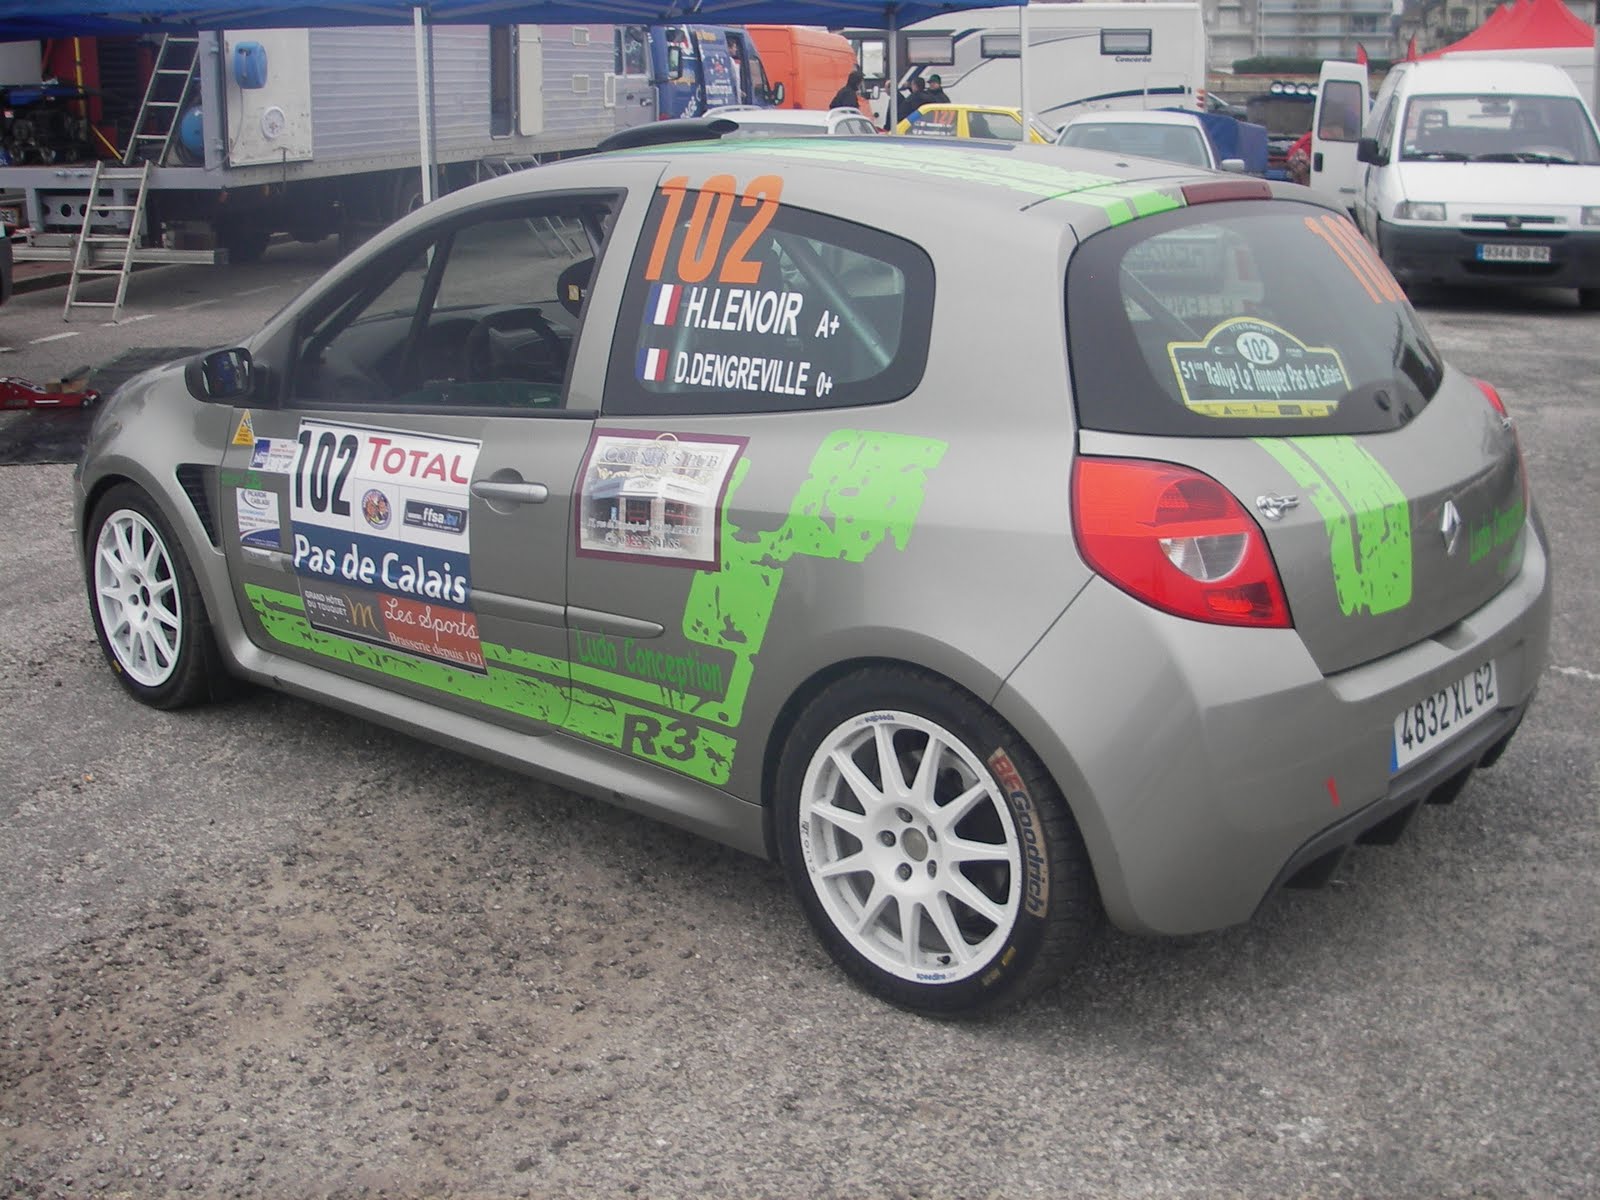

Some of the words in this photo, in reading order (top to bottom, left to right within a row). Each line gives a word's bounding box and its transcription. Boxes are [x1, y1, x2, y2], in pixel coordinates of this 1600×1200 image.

[643, 174, 784, 284] 102
[684, 287, 803, 336] H.LENOIR
[815, 310, 840, 338] A+
[1243, 338, 1274, 361] 102
[674, 352, 811, 396] D.DENGREVILLE
[1204, 362, 1239, 394] Rallye
[1234, 362, 1253, 391] Le
[1247, 362, 1292, 399] Touquet
[1286, 363, 1307, 391] Pas
[1304, 364, 1319, 389] de
[1315, 364, 1342, 386] Calais
[295, 430, 359, 517] 102
[368, 437, 469, 484] TOTAL
[294, 533, 336, 575] Pas
[341, 543, 376, 584] de
[381, 552, 467, 604] Calais
[304, 590, 326, 602] GRAND
[307, 600, 318, 610] DU
[318, 602, 347, 615] TOUQUET
[384, 598, 417, 625] Les
[418, 605, 480, 642] Sports
[388, 631, 431, 653] Brasserie
[432, 642, 465, 661] depuis
[575, 625, 617, 669] Ludo
[623, 636, 723, 698] Conception
[1402, 689, 1450, 750] 4832
[1450, 678, 1473, 722] XL
[1474, 661, 1494, 706] 62
[621, 713, 700, 761] R3
